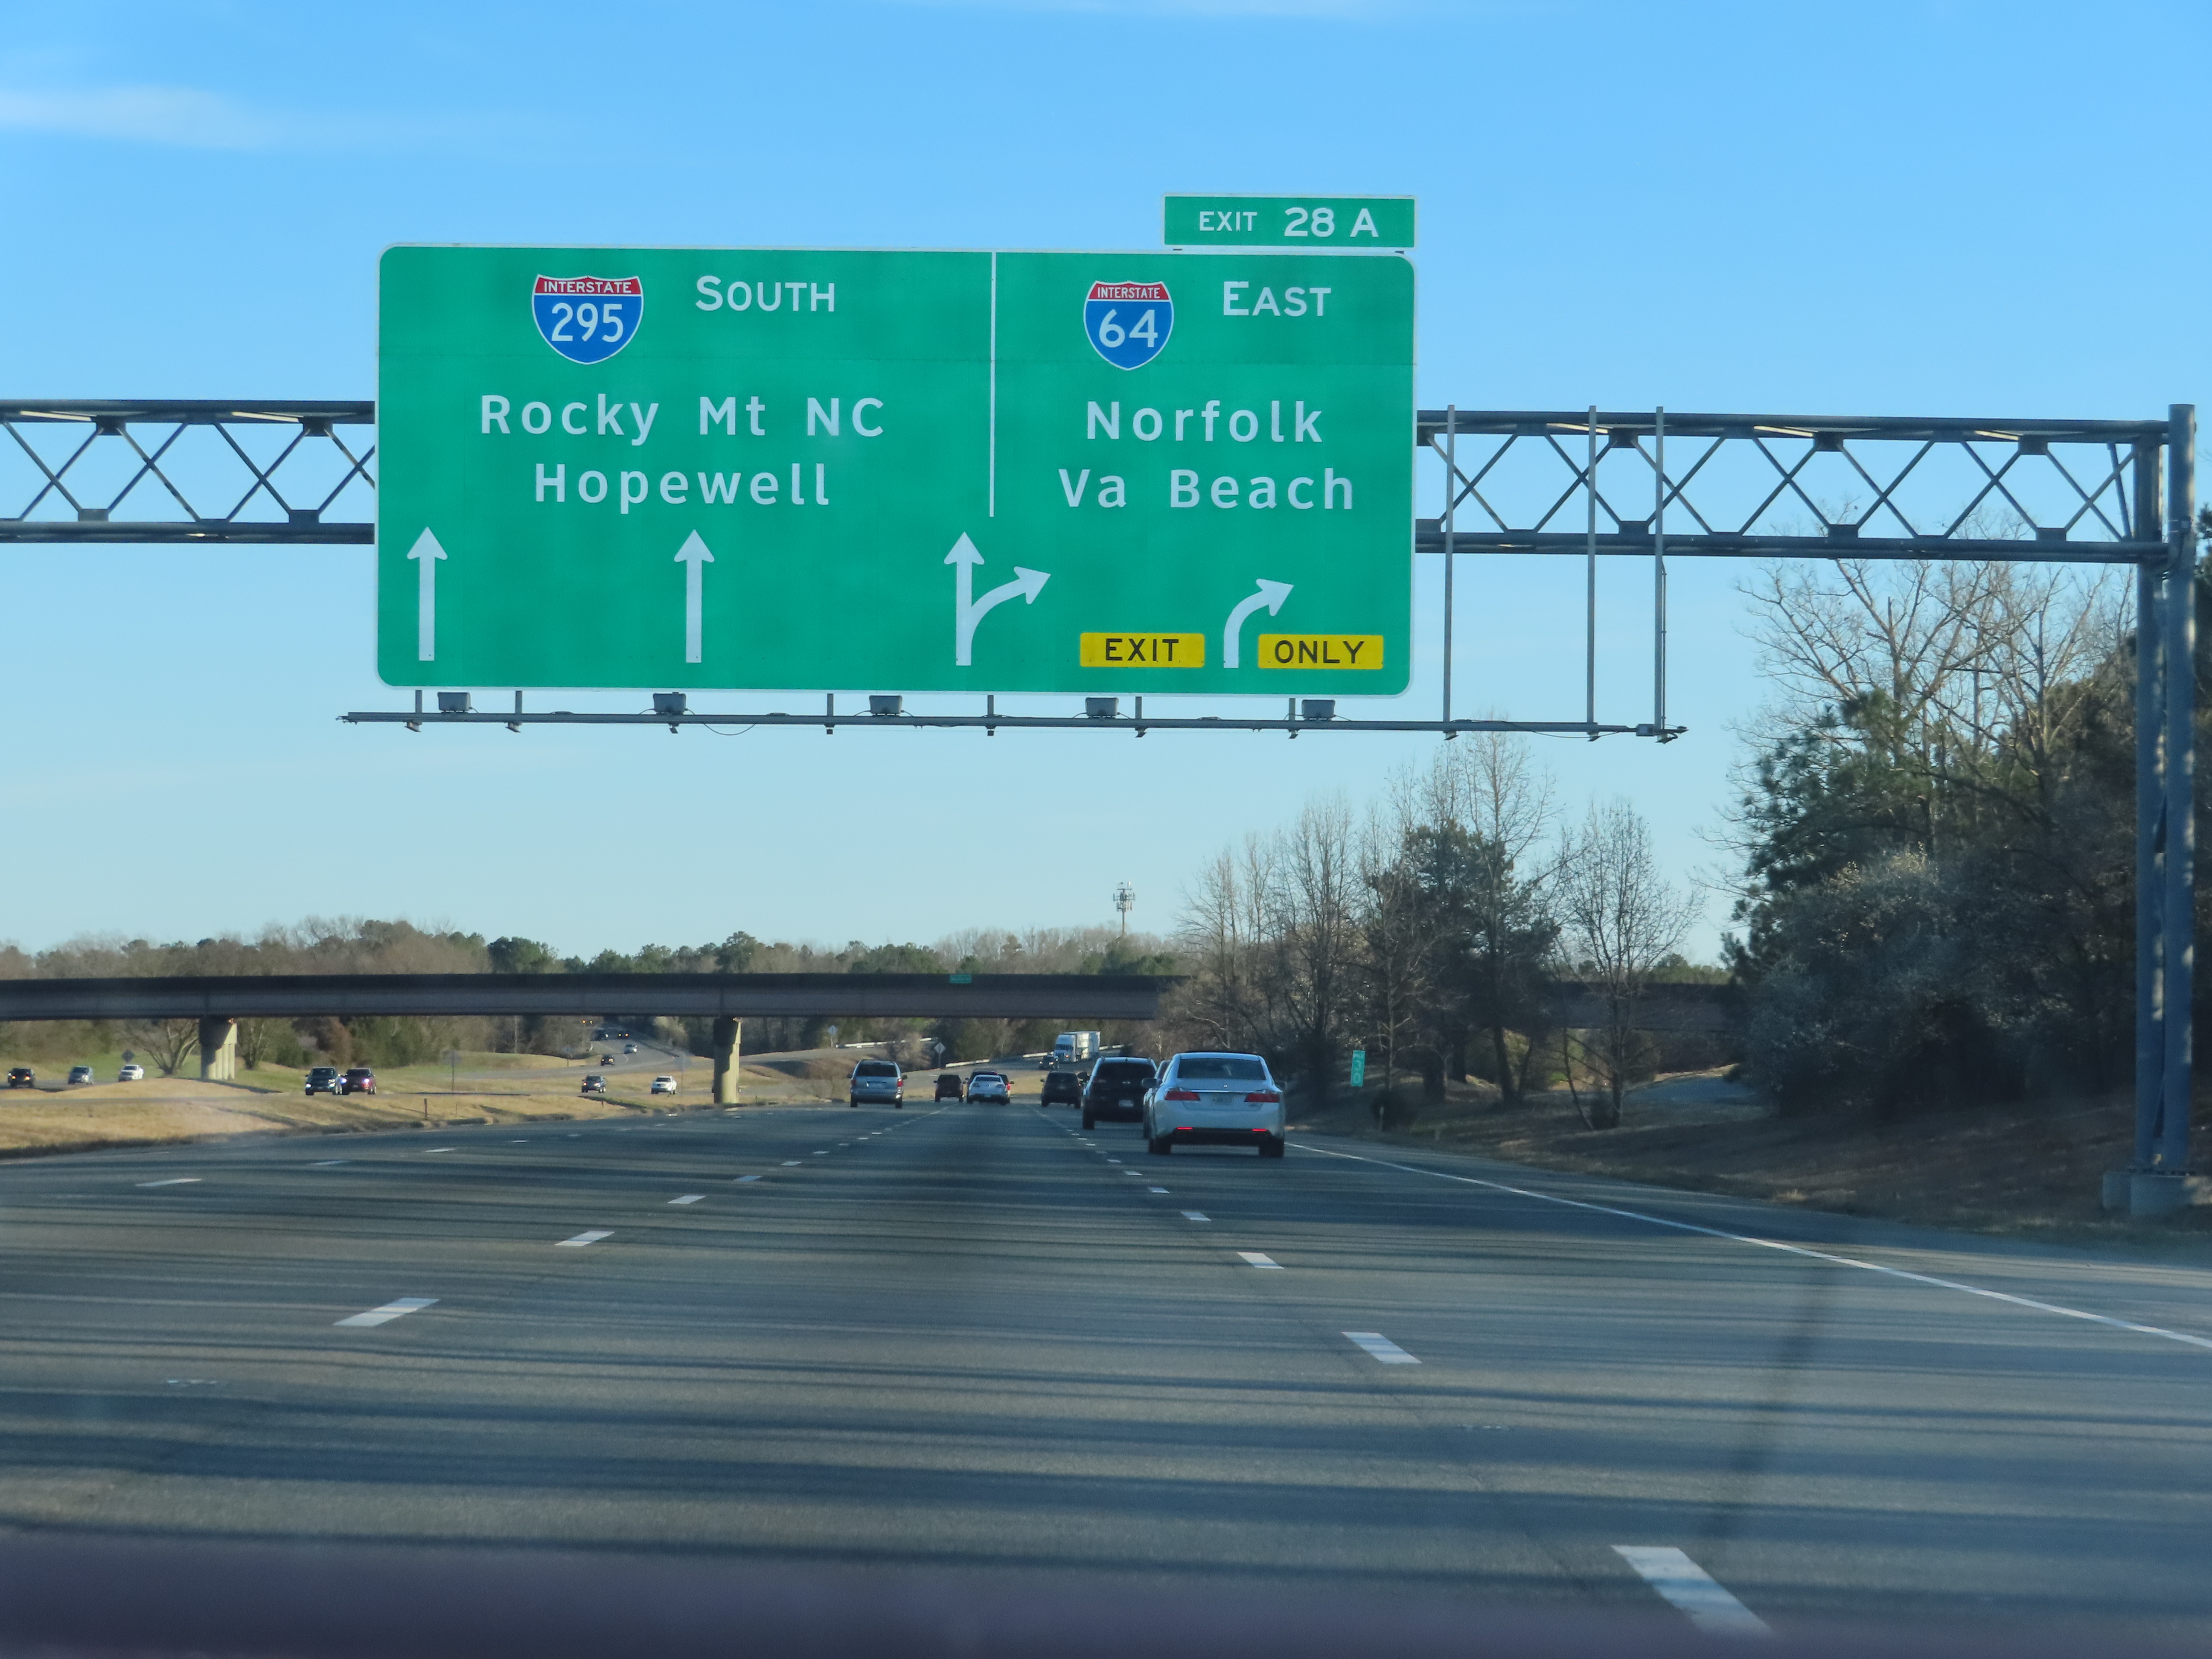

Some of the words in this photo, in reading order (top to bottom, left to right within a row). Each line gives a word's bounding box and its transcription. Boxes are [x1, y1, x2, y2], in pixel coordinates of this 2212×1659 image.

[1200, 212, 1257, 231] EXIT
[1284, 207, 1334, 237] 28
[1350, 209, 1378, 237] A
[544, 281, 632, 294] INTERSTATE
[696, 276, 834, 311] SOUTH
[1097, 287, 1160, 299] INTERSTATE
[1224, 281, 1331, 316] EAST
[552, 303, 623, 342] 295
[1099, 309, 1158, 348] 64
[482, 394, 658, 445] Rocky
[700, 396, 765, 435] Mt
[808, 398, 883, 437] NC
[1088, 400, 1322, 442] Norfolk
[536, 463, 829, 514] Hopewell
[1059, 469, 1126, 507] Va
[1171, 468, 1351, 509] Beach
[1105, 638, 1179, 662] EXIT
[1274, 640, 1365, 664] ONLY
